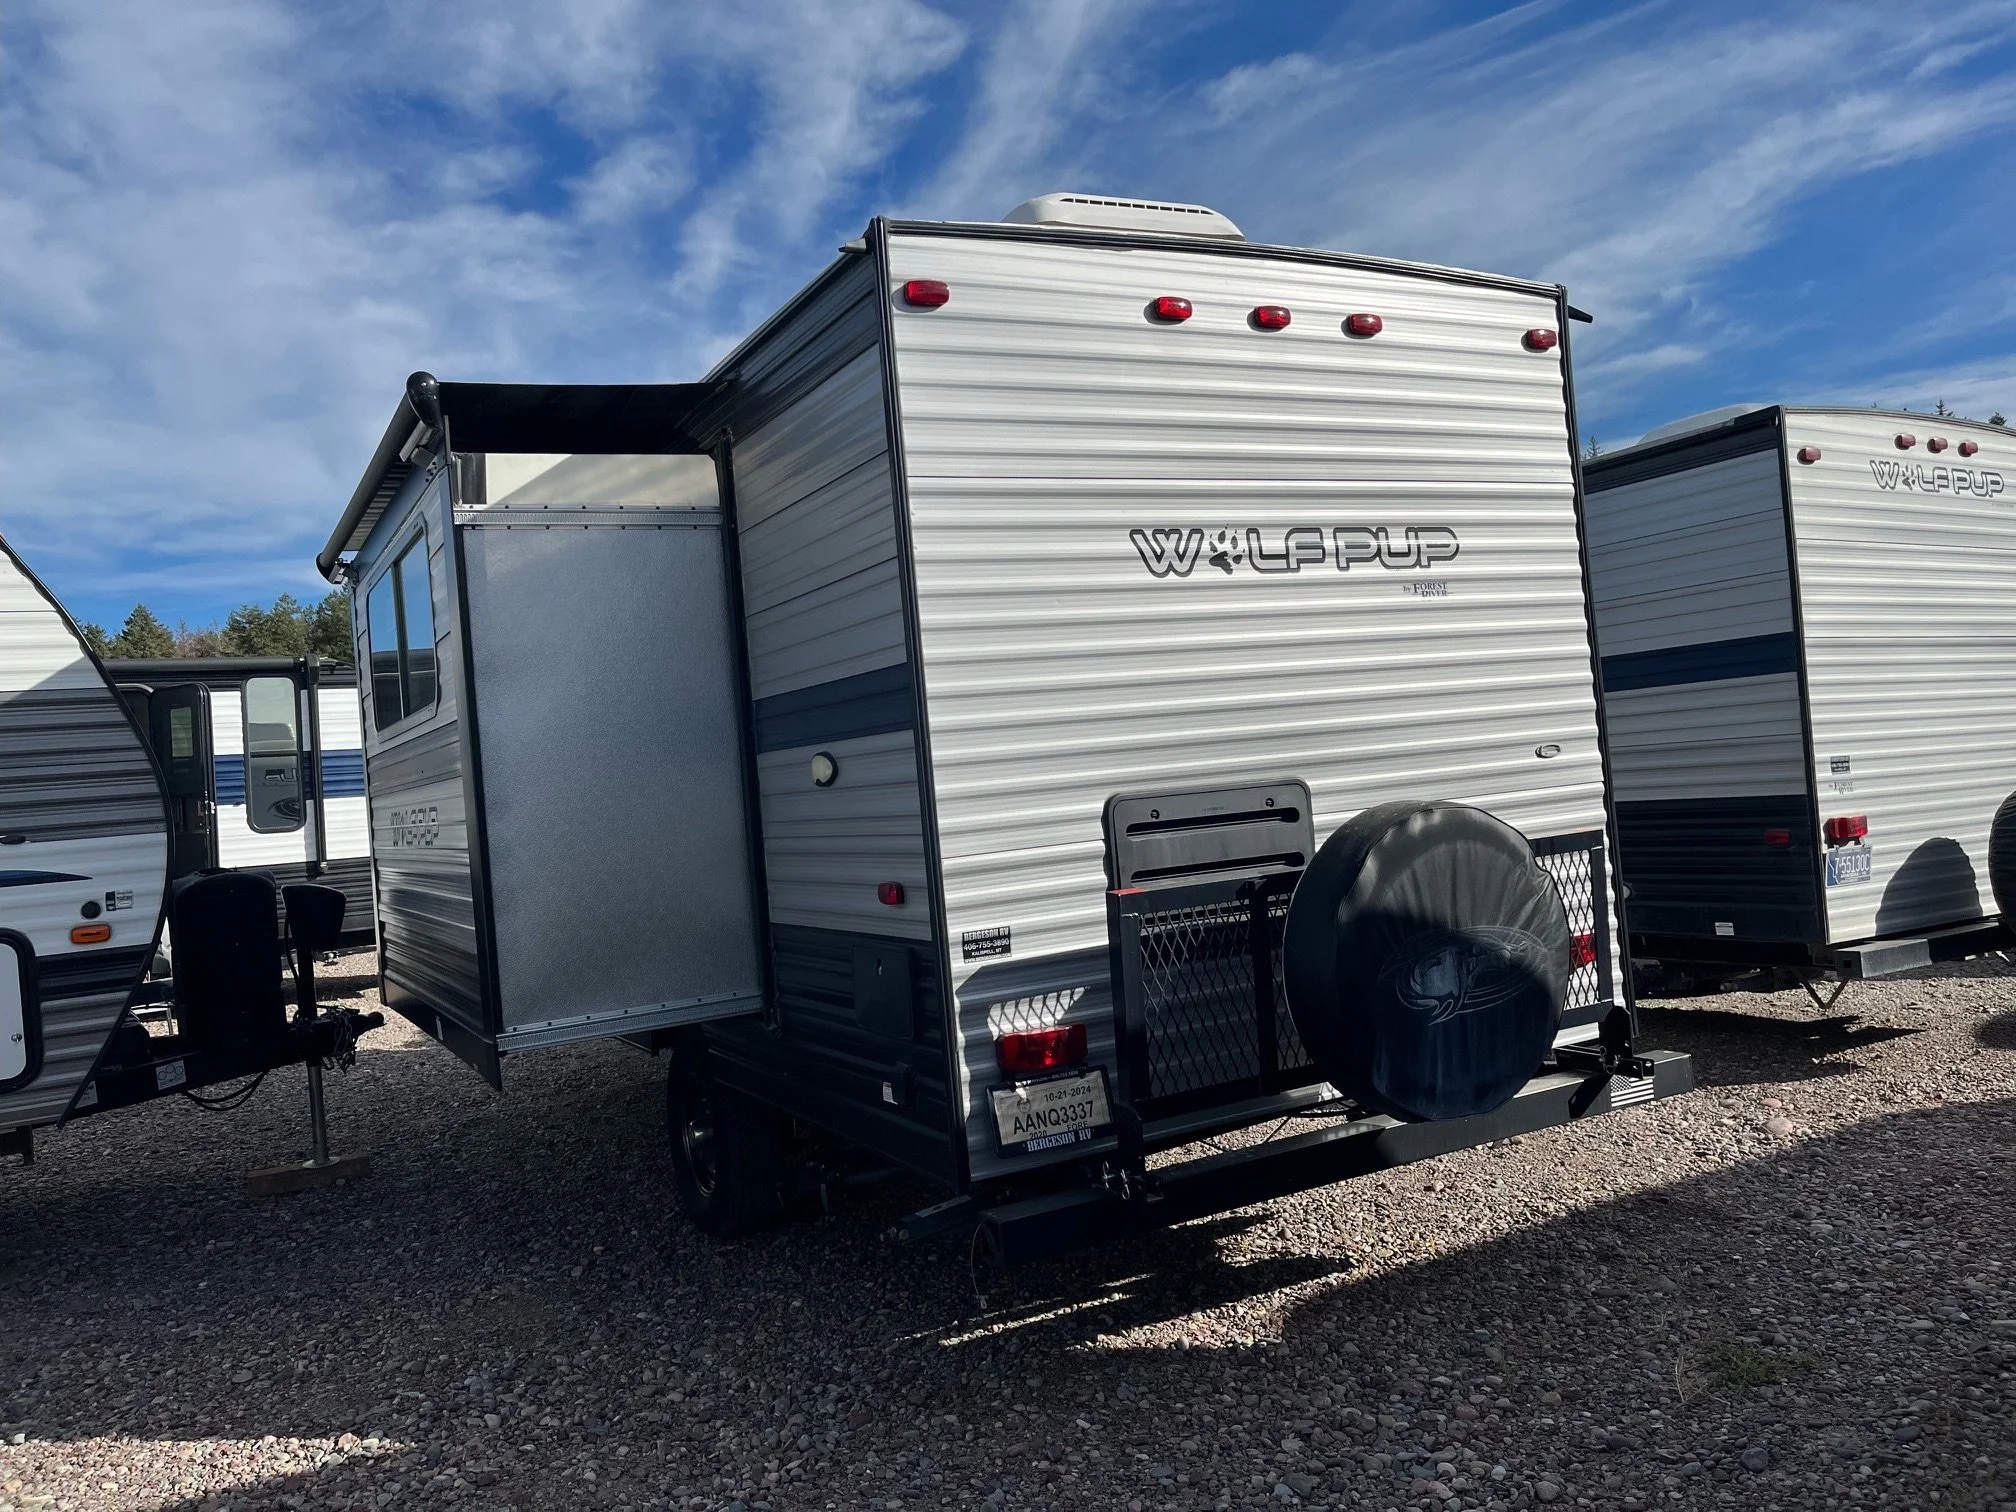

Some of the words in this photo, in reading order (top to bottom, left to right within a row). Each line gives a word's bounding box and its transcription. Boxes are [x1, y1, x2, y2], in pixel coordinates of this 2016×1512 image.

[1413, 582, 1447, 594] FOREST
[963, 929, 999, 942] BERGESON
[999, 927, 1009, 937] RV
[1044, 1085, 1091, 1102] 10-21-2024
[1013, 1101, 1094, 1135] AANQ3337
[1026, 1131, 1076, 1152] BERGESON
[1079, 1128, 1092, 1141] RV
[1029, 1130, 1048, 1140] 2020
